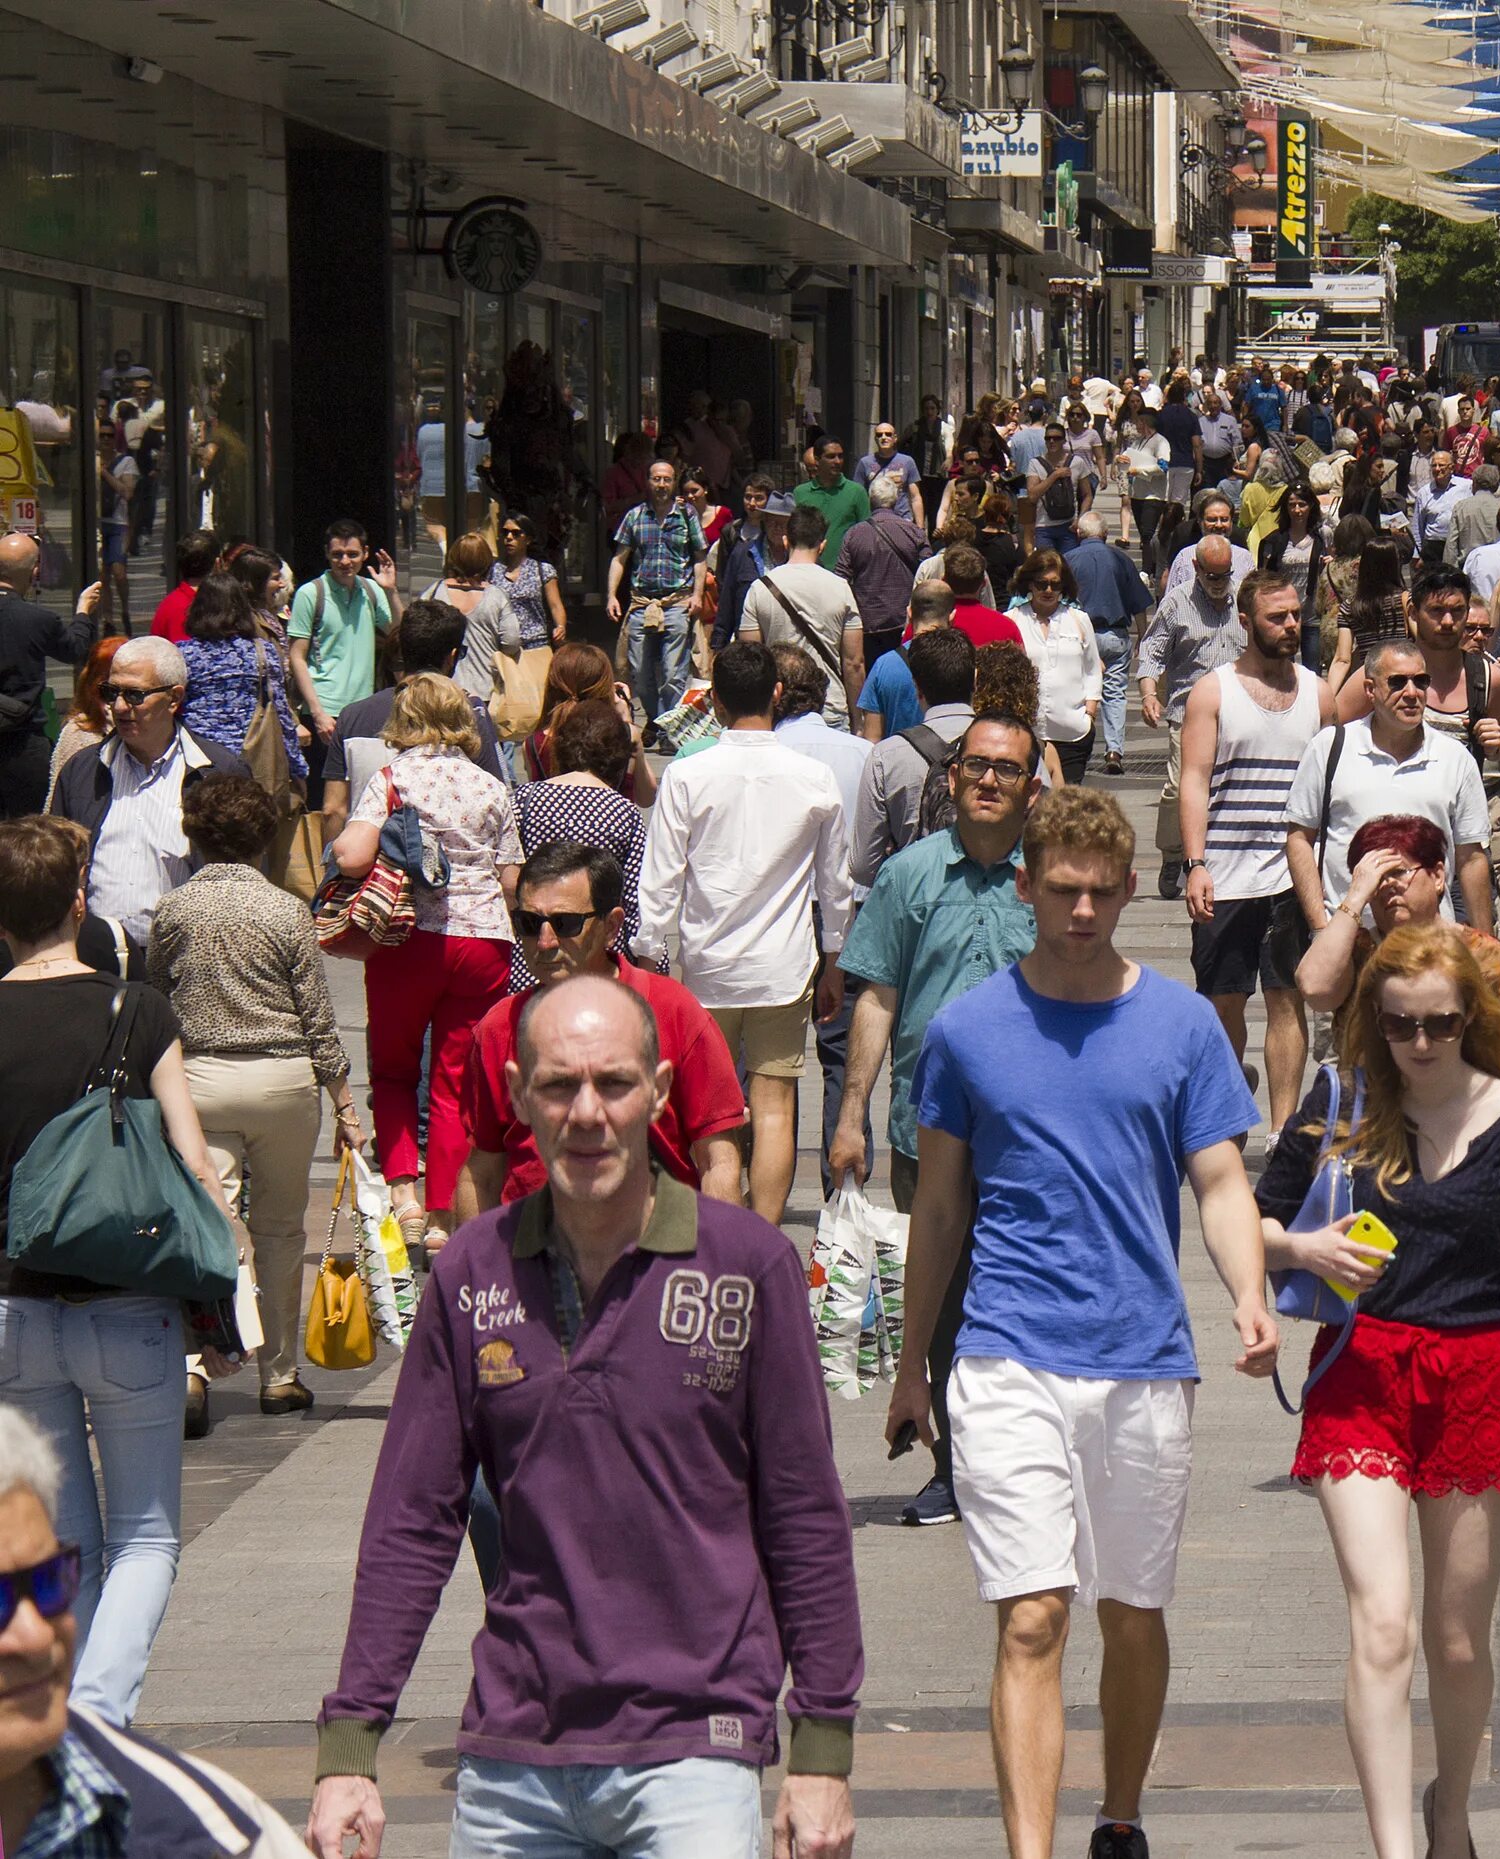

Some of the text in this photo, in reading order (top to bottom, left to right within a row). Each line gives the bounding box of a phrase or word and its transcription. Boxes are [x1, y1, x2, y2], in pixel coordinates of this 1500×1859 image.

[962, 134, 1038, 156] anubio
[963, 153, 1001, 174] zul
[1281, 121, 1306, 257] Atrezzo
[1105, 266, 1150, 274] CALZEDONIA
[16, 502, 35, 519] 18
[474, 1301, 526, 1331] Creek
[659, 1268, 755, 1351] 68
